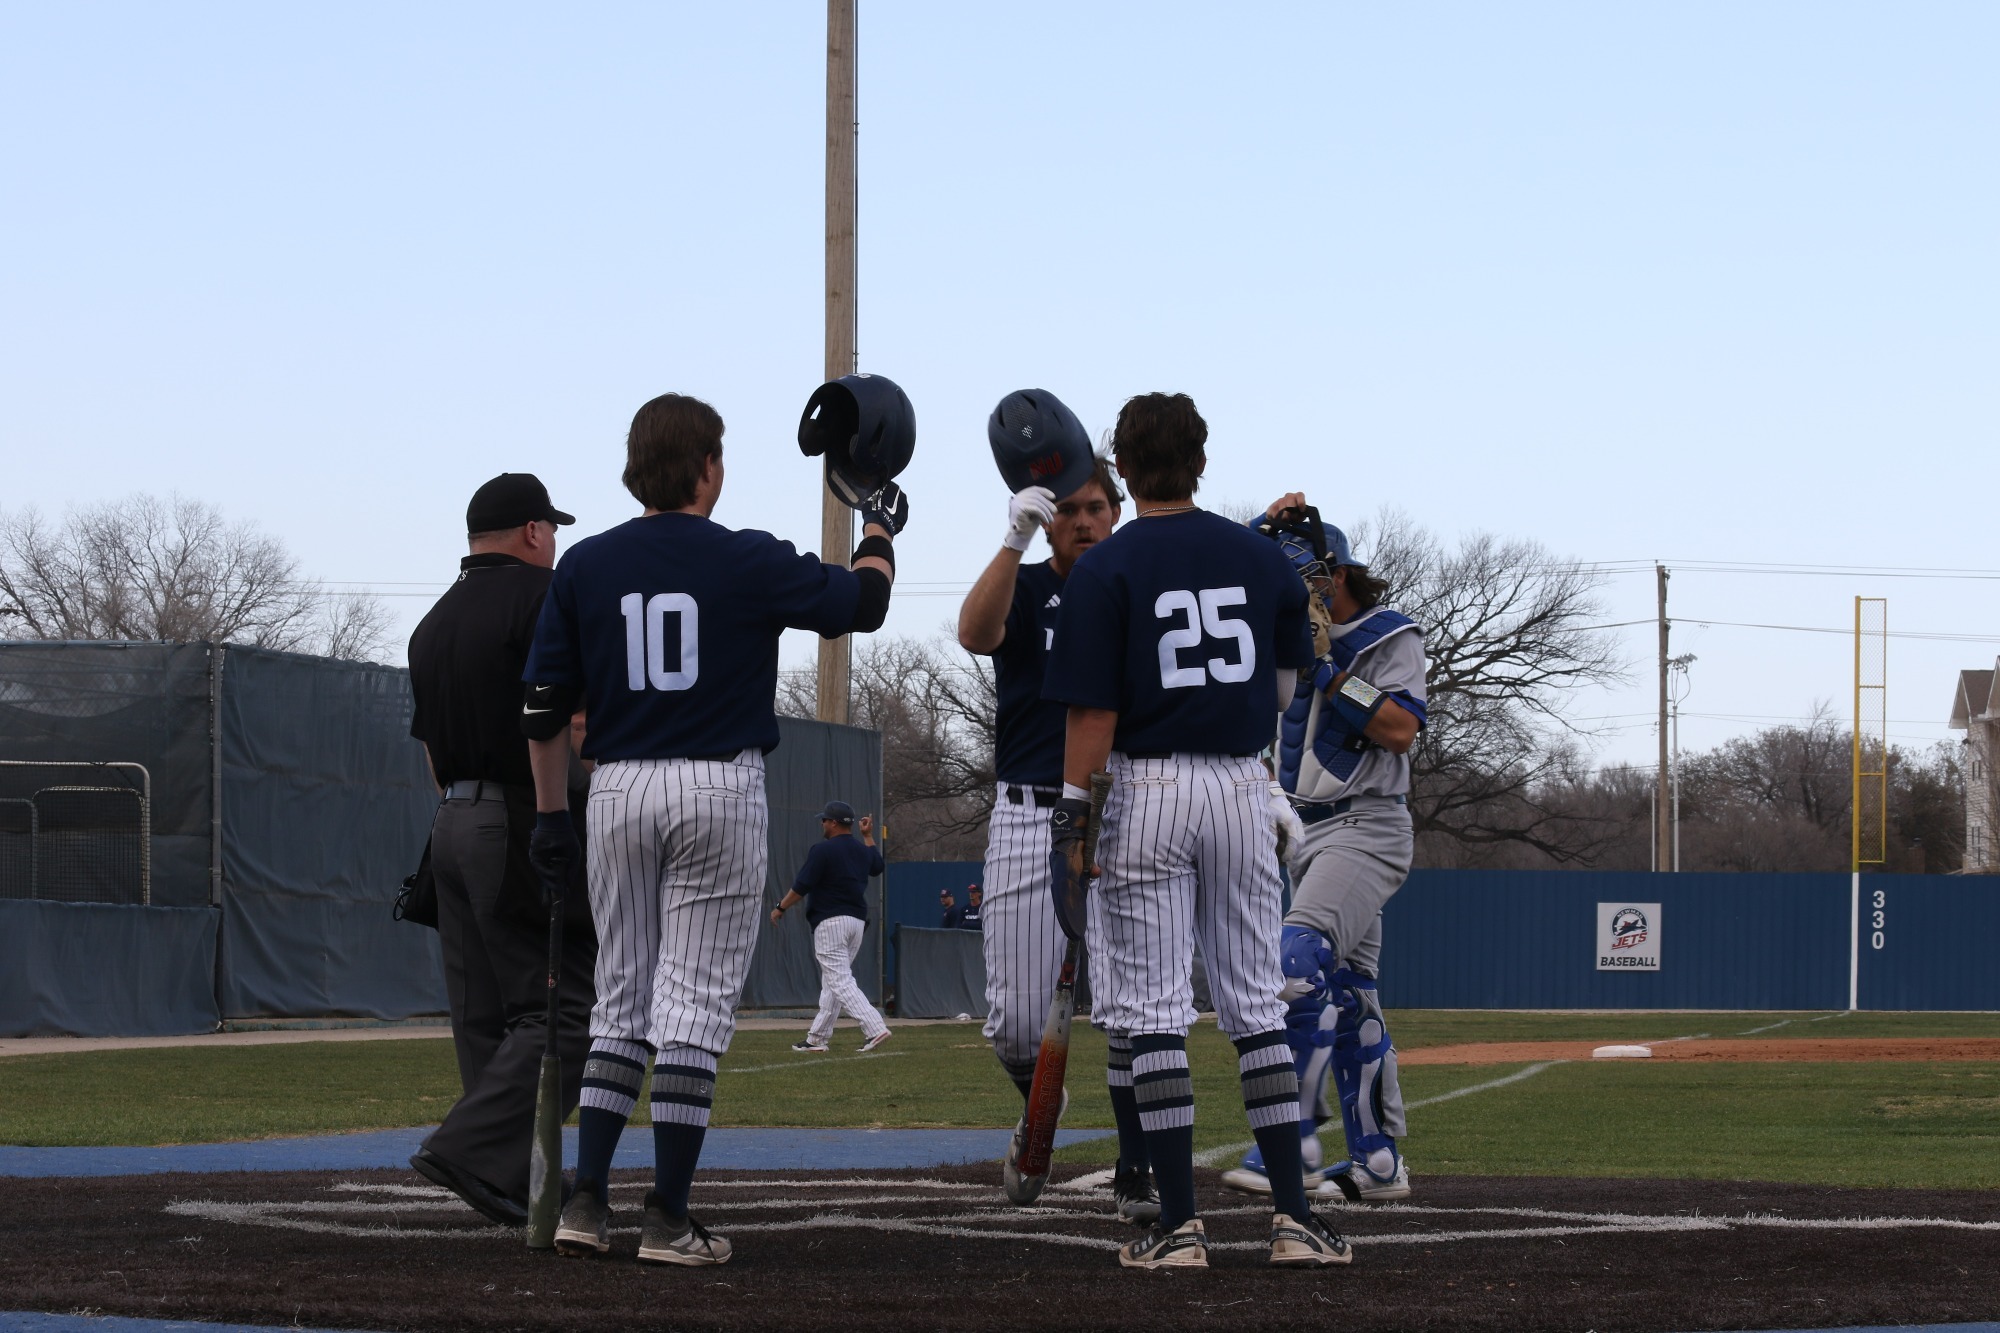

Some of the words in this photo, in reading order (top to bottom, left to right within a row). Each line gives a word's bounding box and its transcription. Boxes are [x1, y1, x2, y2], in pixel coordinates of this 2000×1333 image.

[621, 592, 699, 691] 10
[1155, 586, 1255, 689] 25
[1617, 909, 1644, 919] NEWMAN
[1872, 890, 1885, 949] 330
[1612, 932, 1648, 948] JETS
[1600, 957, 1656, 966] BASEBALL
